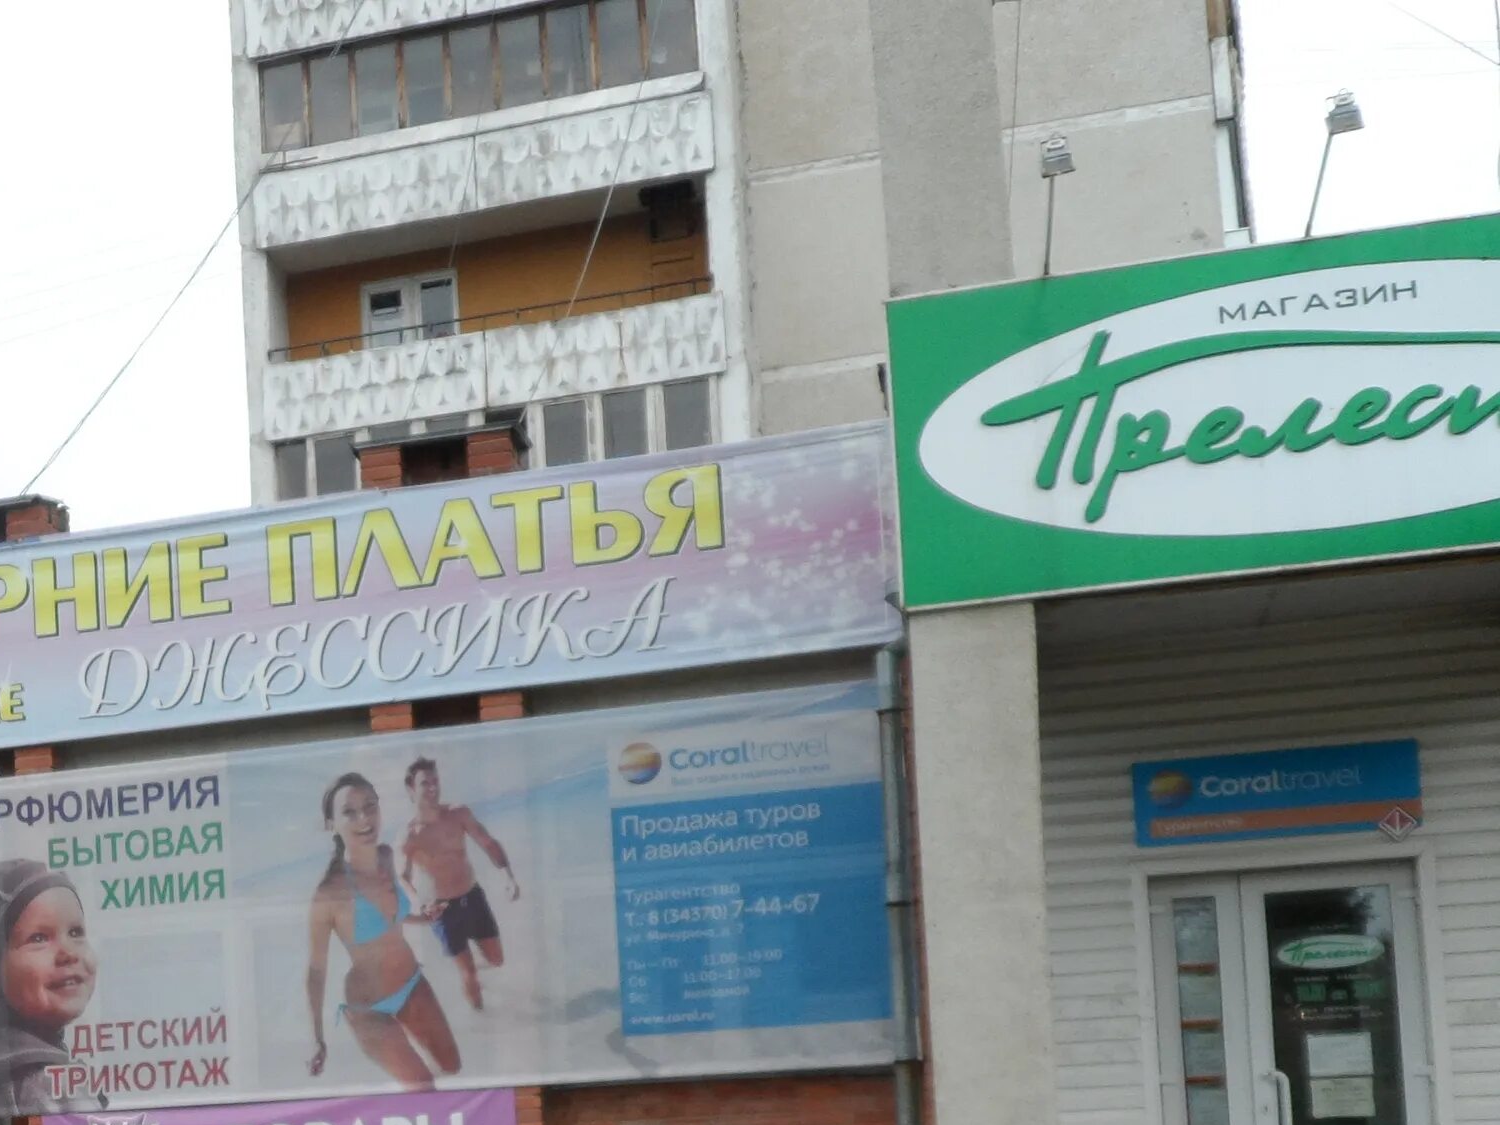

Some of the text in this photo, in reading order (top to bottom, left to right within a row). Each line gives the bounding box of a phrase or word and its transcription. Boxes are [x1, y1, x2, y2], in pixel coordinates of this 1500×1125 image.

[1218, 279, 1418, 325] МАГАЗИН
[266, 463, 726, 606] ПЛАТЬЯ
[78, 576, 678, 719] ДЖЕССИКА
[620, 802, 822, 840] Продажа туров
[48, 822, 225, 871] БЫТОВАЯ
[622, 830, 810, 863] и авиабилетов
[100, 869, 227, 910] ХИМИЯ
[622, 883, 741, 906] Турагентство
[71, 1008, 229, 1059] ДЕТСКИЙ
[47, 1057, 231, 1099] ТРИКОТАЖ
